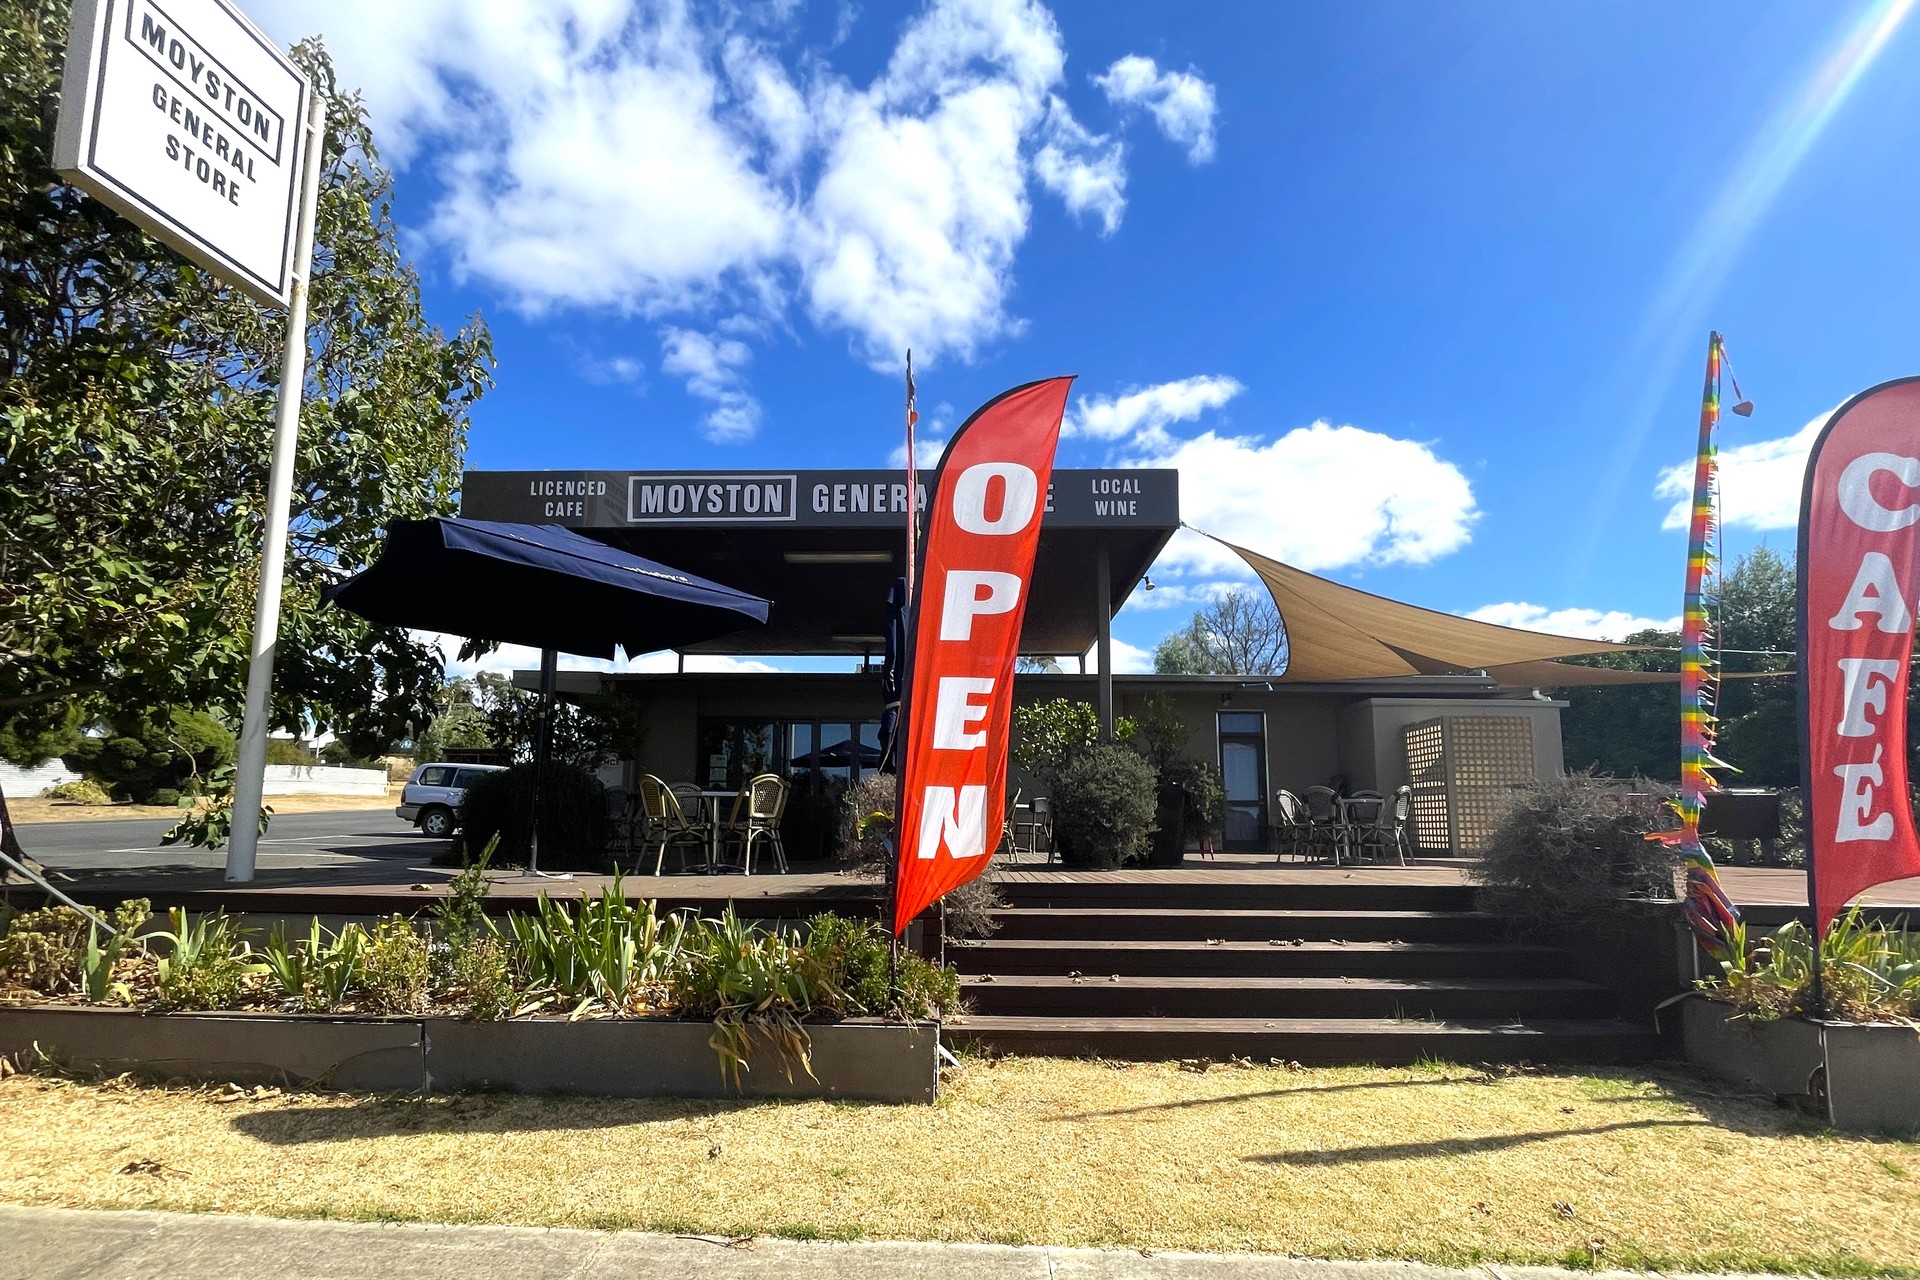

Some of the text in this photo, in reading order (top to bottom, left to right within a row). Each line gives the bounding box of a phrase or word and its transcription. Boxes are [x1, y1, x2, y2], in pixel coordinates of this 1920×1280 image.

[142, 11, 270, 143] MOYSTON
[152, 82, 257, 184] GENERAL
[165, 133, 241, 207] STORE
[530, 480, 607, 496] LICENCED
[640, 484, 783, 513] MOYSTON
[812, 484, 928, 513] GENERA
[1091, 478, 1142, 495] LOCAL
[544, 501, 583, 517] CAFE
[1094, 500, 1138, 516] WINE
[917, 461, 1039, 860] OPEN
